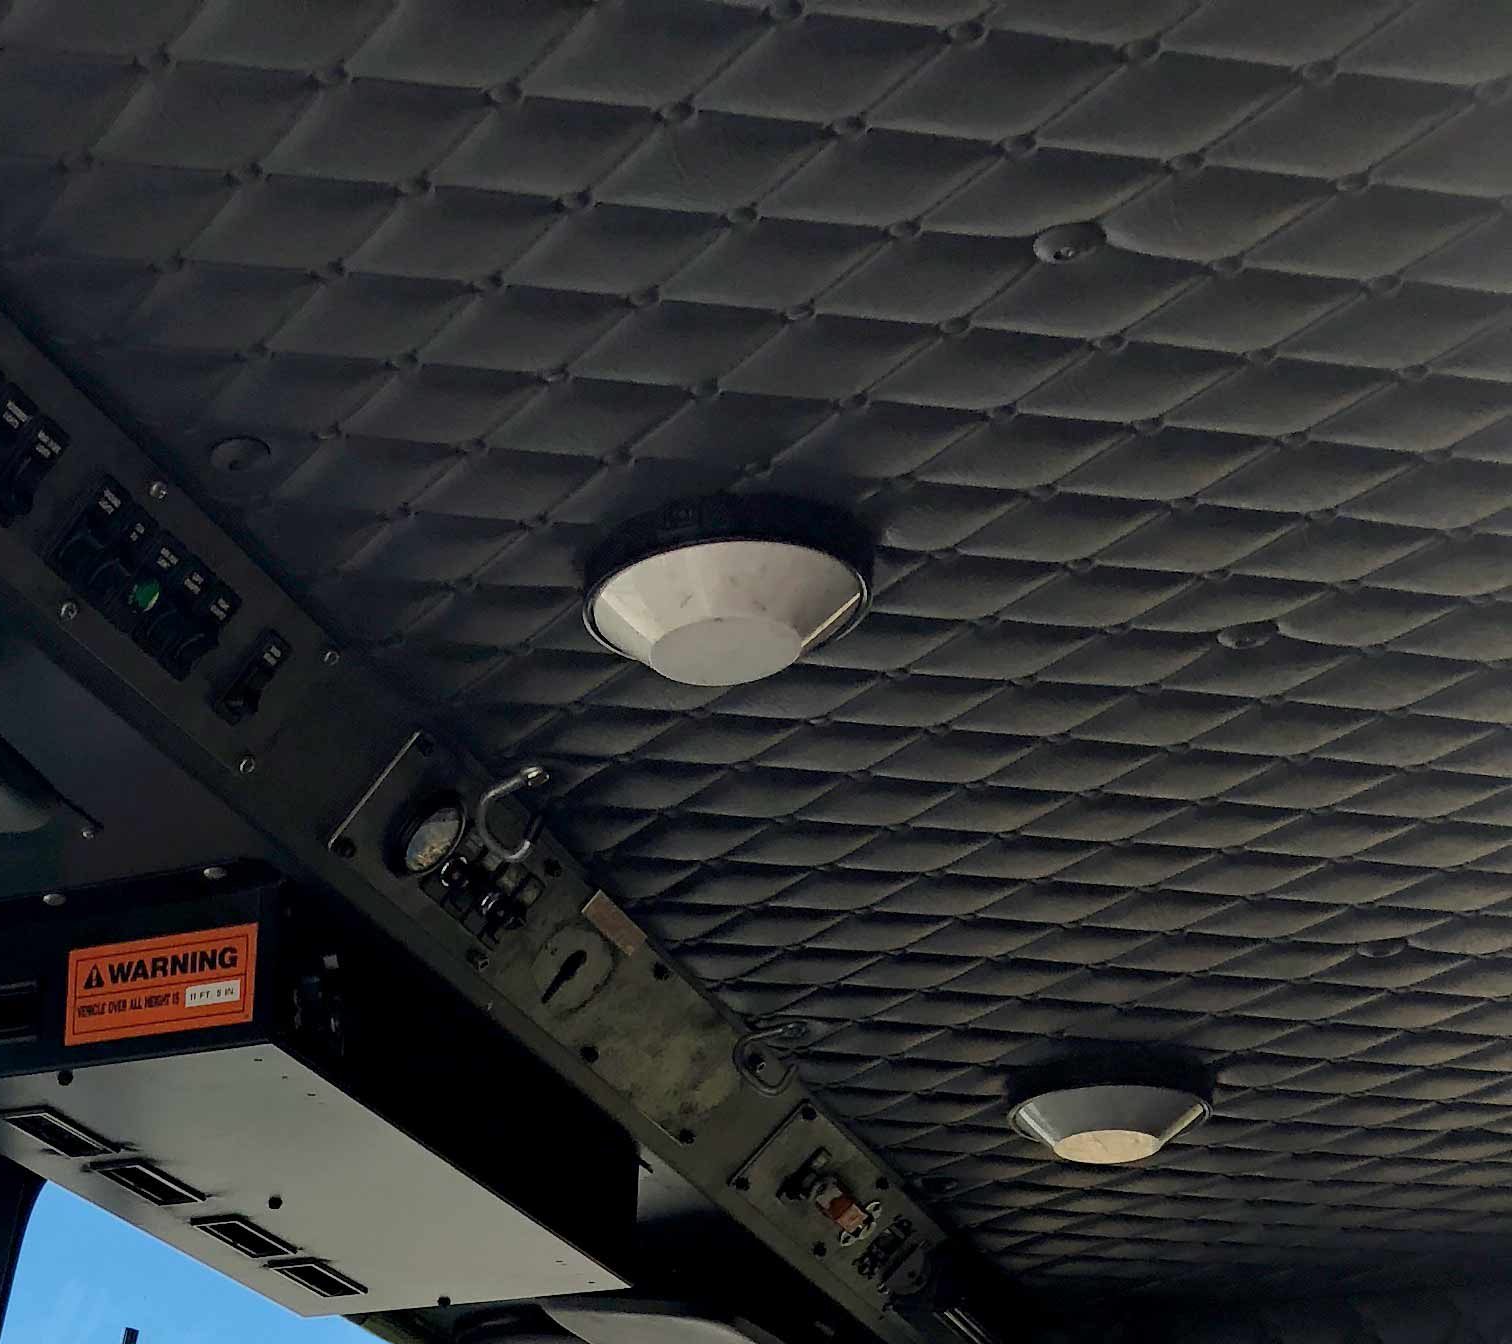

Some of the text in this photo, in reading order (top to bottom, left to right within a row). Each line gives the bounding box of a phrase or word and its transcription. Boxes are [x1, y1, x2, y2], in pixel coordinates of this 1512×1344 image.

[108, 947, 237, 984] WARNING
[77, 992, 180, 1018] VEHICLE OVER ALL HEIGHT IS
[199, 991, 211, 1000] FT
